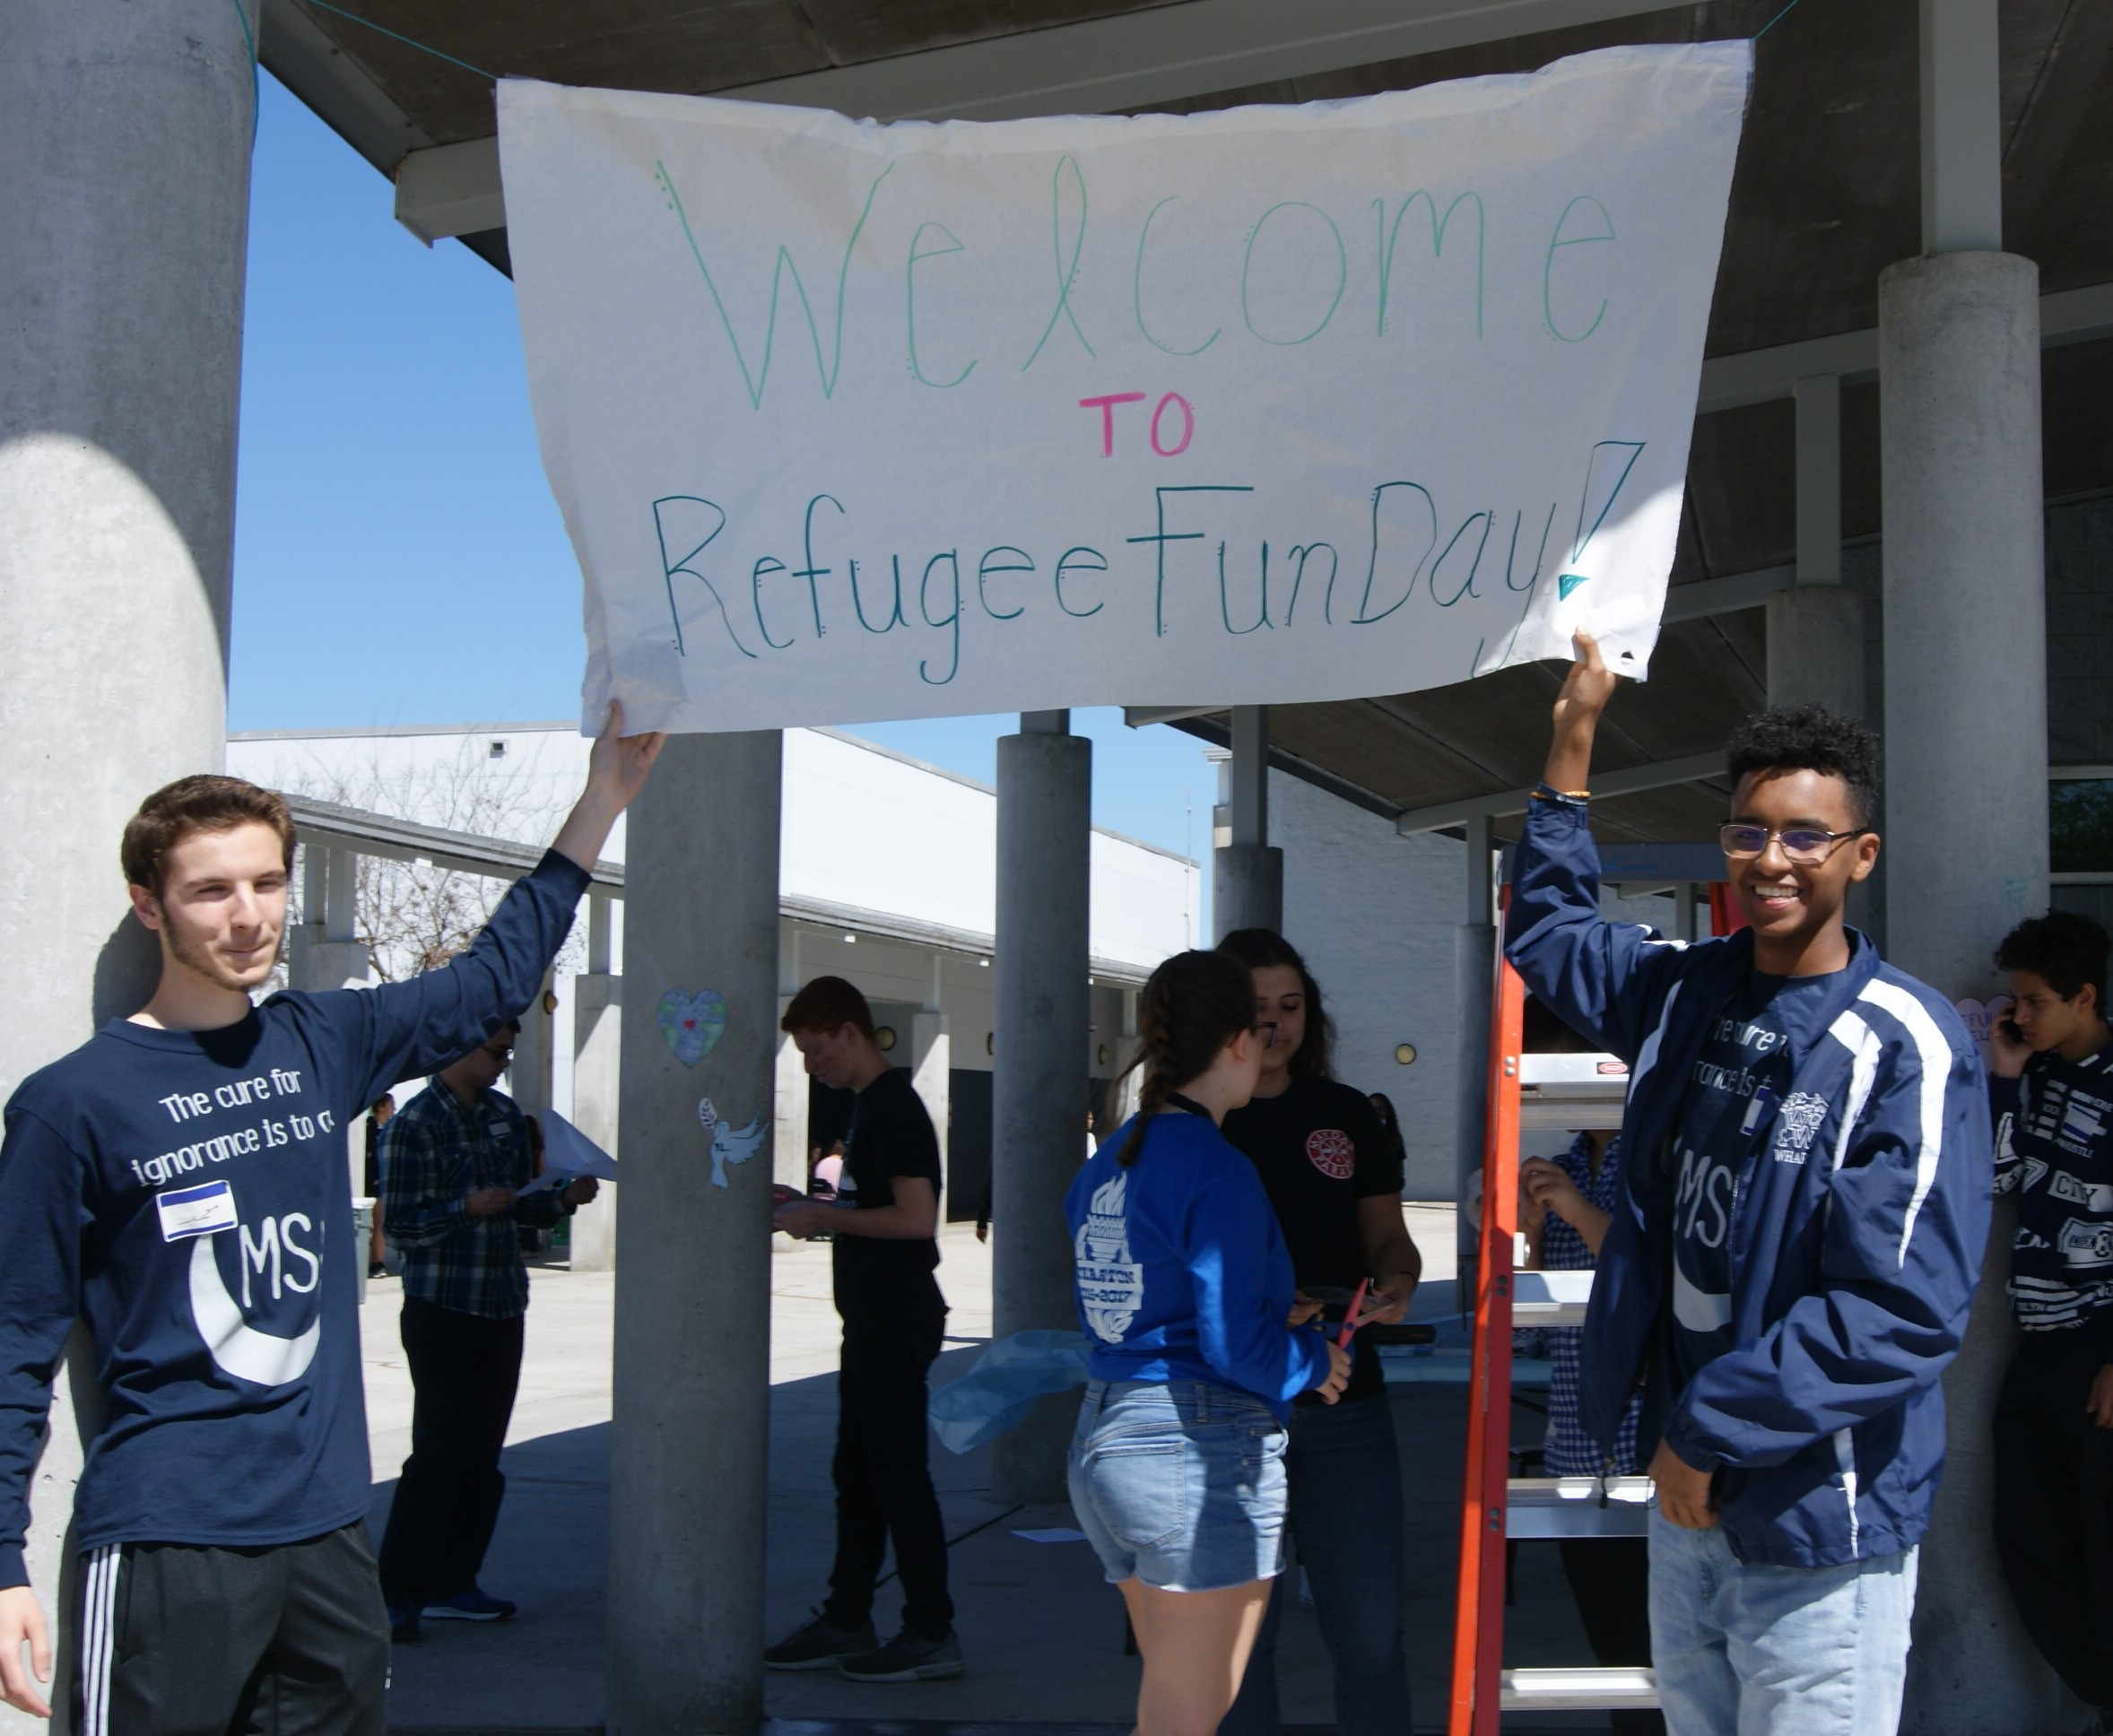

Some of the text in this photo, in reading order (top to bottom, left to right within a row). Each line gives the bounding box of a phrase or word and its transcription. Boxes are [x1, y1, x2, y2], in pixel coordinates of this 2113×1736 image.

[656, 154, 1615, 411] Welcome
[1079, 391, 1195, 459] TO
[652, 493, 1109, 686] Refugee
[158, 1068, 301, 1124] The cure for
[131, 1127, 261, 1188] ignorance
[262, 1119, 289, 1149] is
[290, 1115, 316, 1140] to
